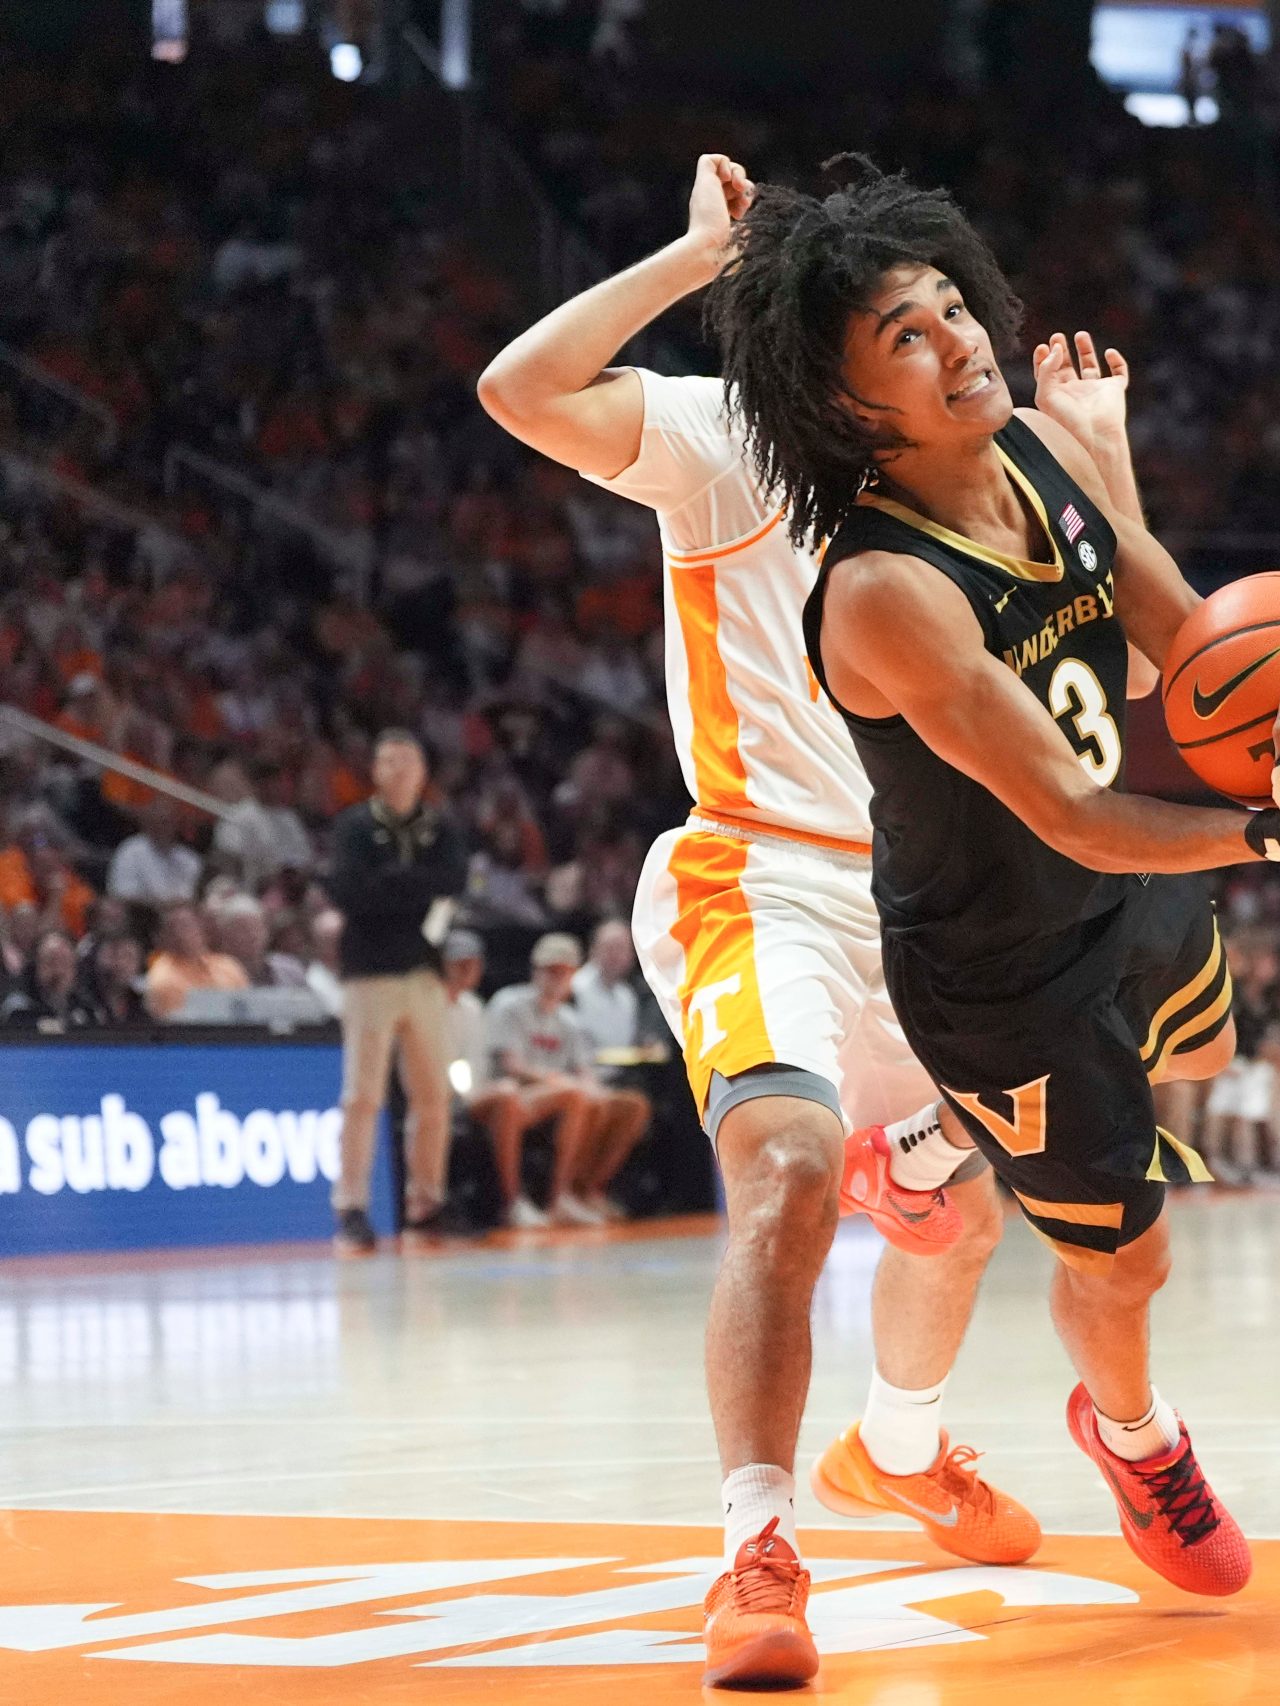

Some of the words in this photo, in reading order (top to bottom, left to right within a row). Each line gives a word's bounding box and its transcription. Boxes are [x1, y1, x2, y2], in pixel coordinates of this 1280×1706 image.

[1048, 657, 1122, 788] 3
[687, 972, 741, 1059] T
[25, 1092, 154, 1195] sub
[940, 1073, 1051, 1158] V
